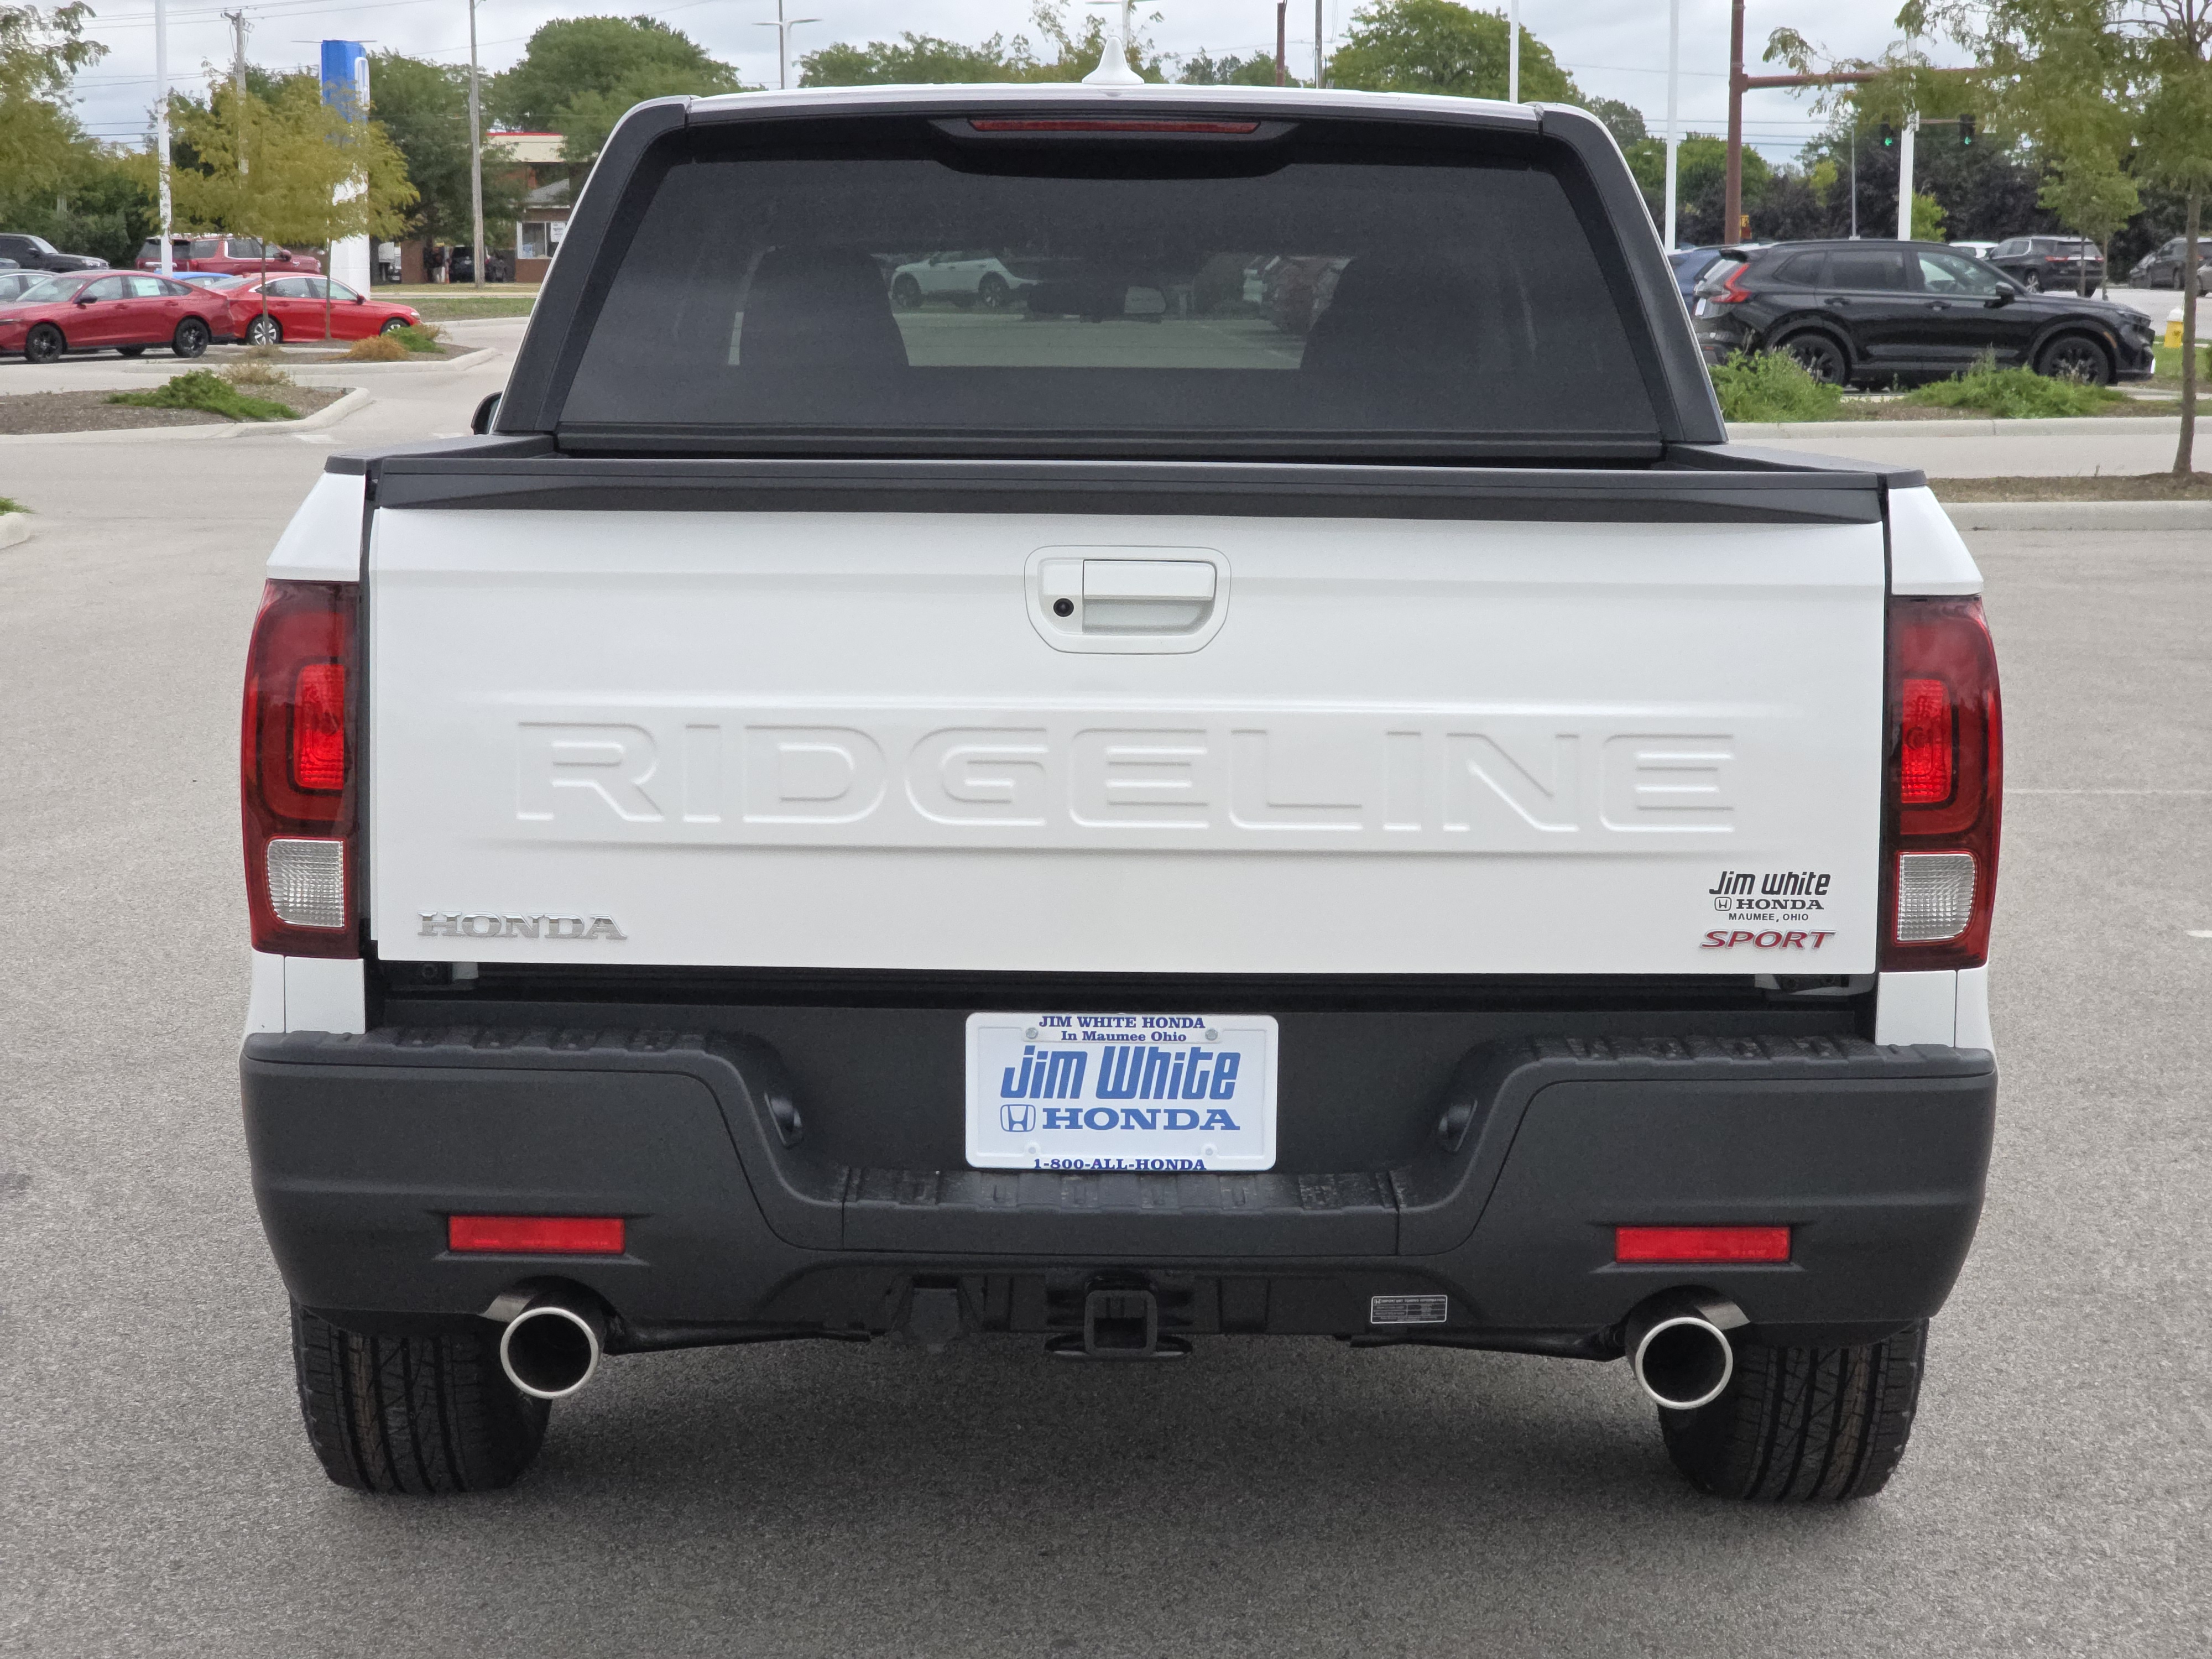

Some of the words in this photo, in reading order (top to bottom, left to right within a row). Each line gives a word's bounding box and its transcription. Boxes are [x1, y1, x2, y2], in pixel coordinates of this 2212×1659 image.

[515, 722, 1735, 832] RIDGELINE
[1709, 871, 1756, 895] Jim
[1736, 899, 1824, 910] HONDA
[417, 911, 628, 940] HONDA
[1729, 913, 1780, 922] MAUMEE,
[1699, 929, 1837, 950] SPORT
[1039, 1016, 1072, 1027] JIM
[1077, 1016, 1137, 1028] WHITE
[1142, 1017, 1206, 1029] HONDA
[1061, 1030, 1077, 1041] In
[1082, 1031, 1146, 1041] Maumee
[1151, 1031, 1187, 1042] Ohio
[1095, 1046, 1241, 1100] White
[1042, 1107, 1240, 1130] HONDA
[1034, 1158, 1207, 1170] 1-800-ALL-HONDA
